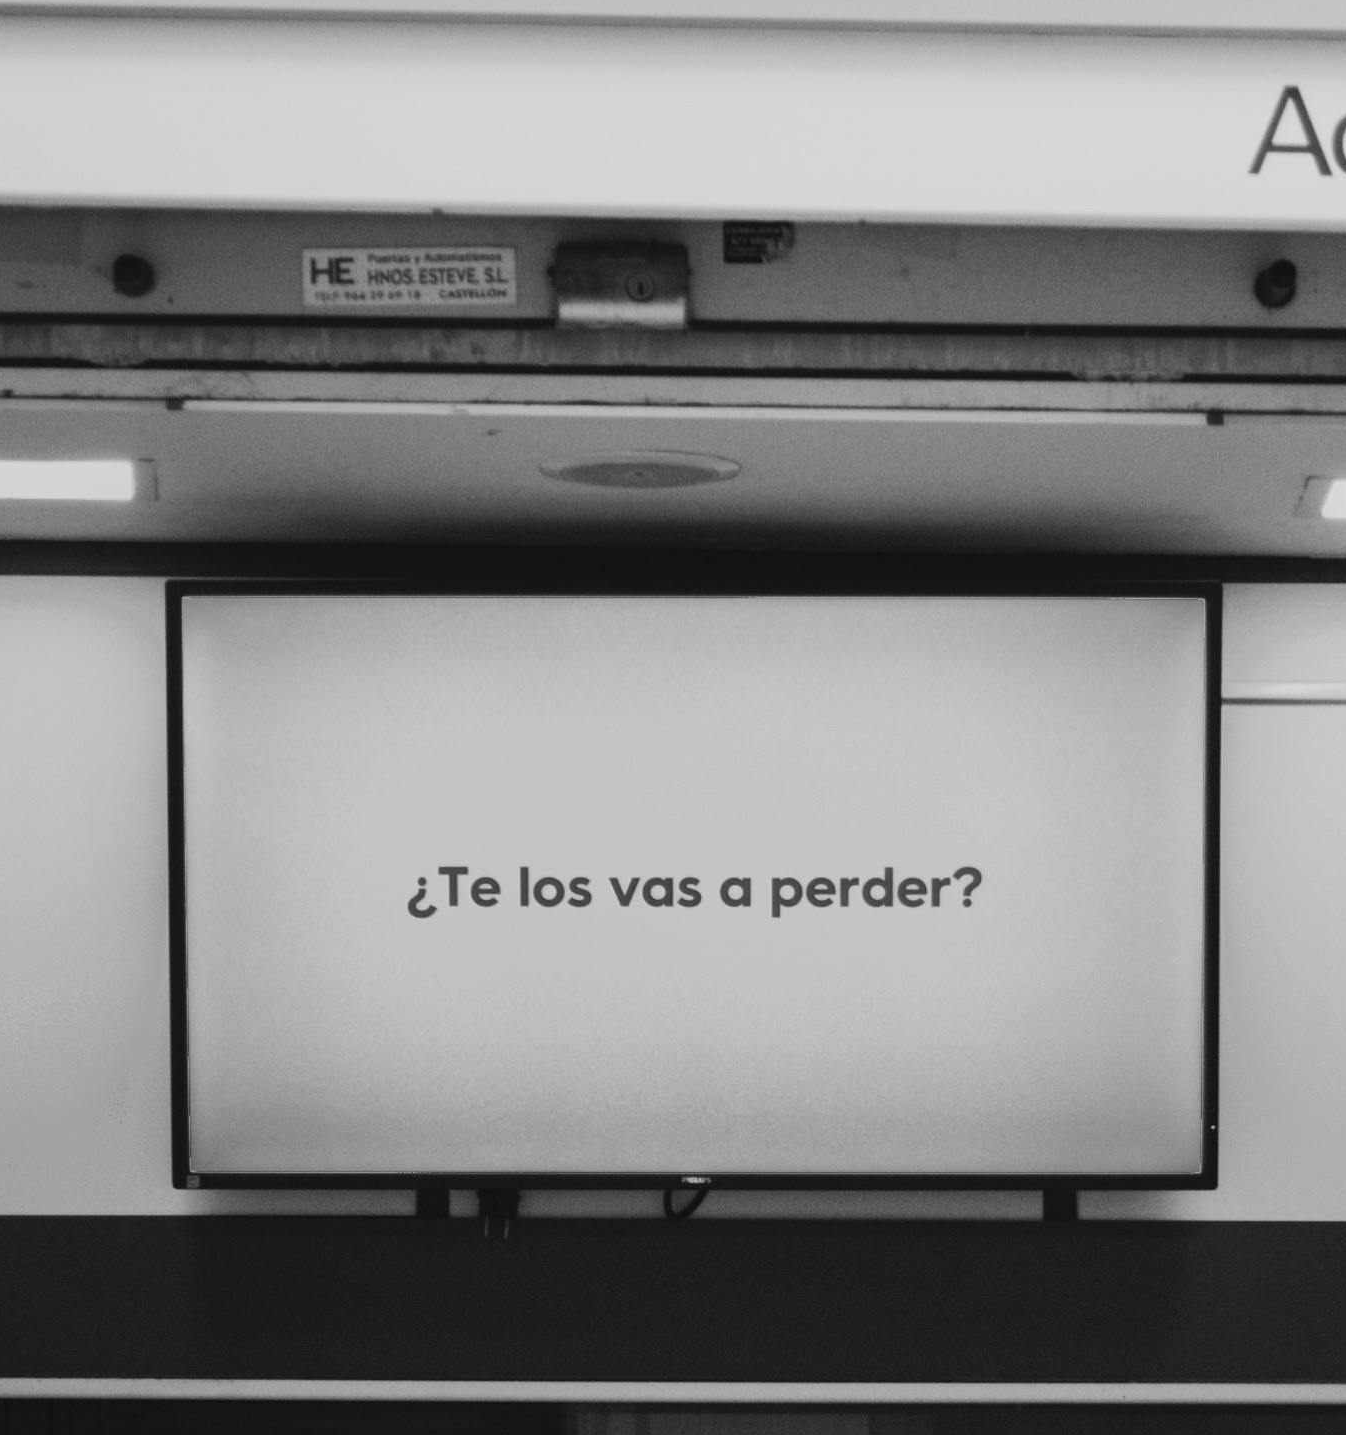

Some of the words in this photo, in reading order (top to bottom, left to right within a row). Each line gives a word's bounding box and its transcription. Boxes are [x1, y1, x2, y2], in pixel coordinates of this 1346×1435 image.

[310, 256, 355, 285] HE
[407, 866, 501, 919] ¿Te
[519, 866, 593, 908] los
[608, 876, 702, 908] vas
[719, 876, 752, 908] a
[771, 866, 983, 919] perder?
